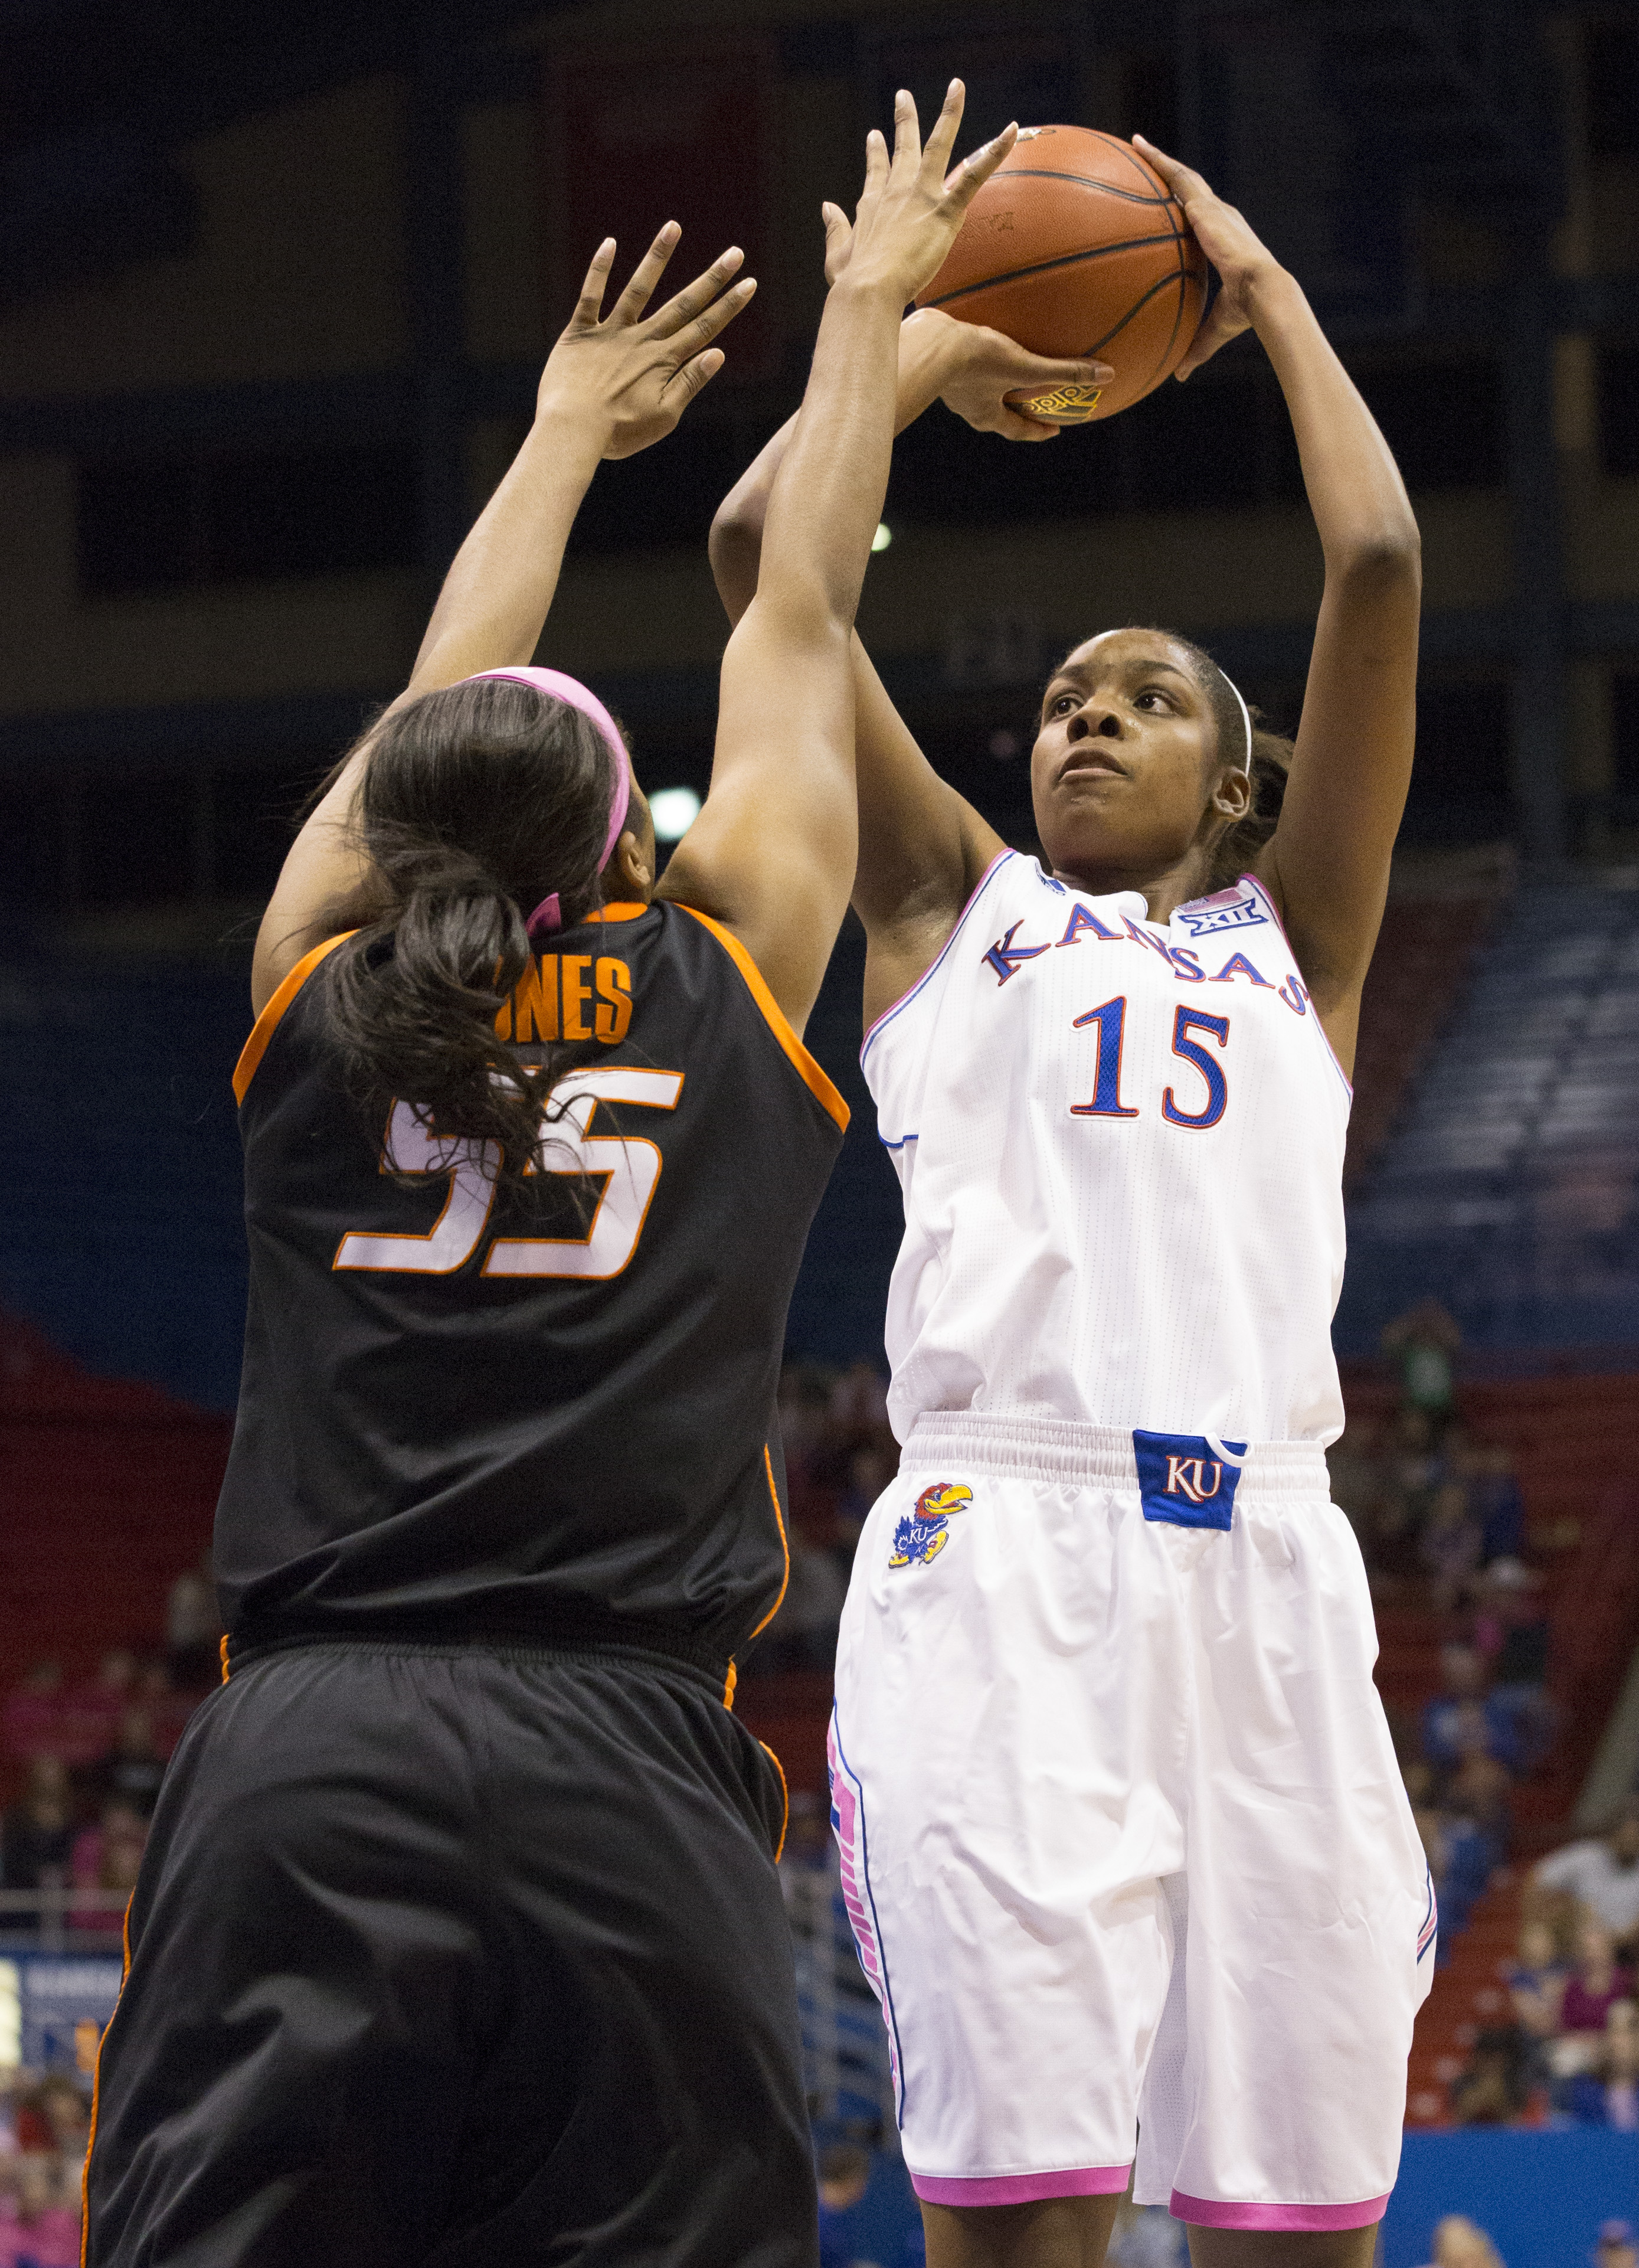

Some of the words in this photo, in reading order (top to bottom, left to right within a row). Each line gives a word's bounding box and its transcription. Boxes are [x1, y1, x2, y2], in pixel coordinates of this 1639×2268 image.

[981, 902, 1310, 1016] KANSAS
[1069, 995, 1231, 1130] 15
[1163, 1455, 1223, 1504] KU
[908, 1527, 928, 1544] KU
